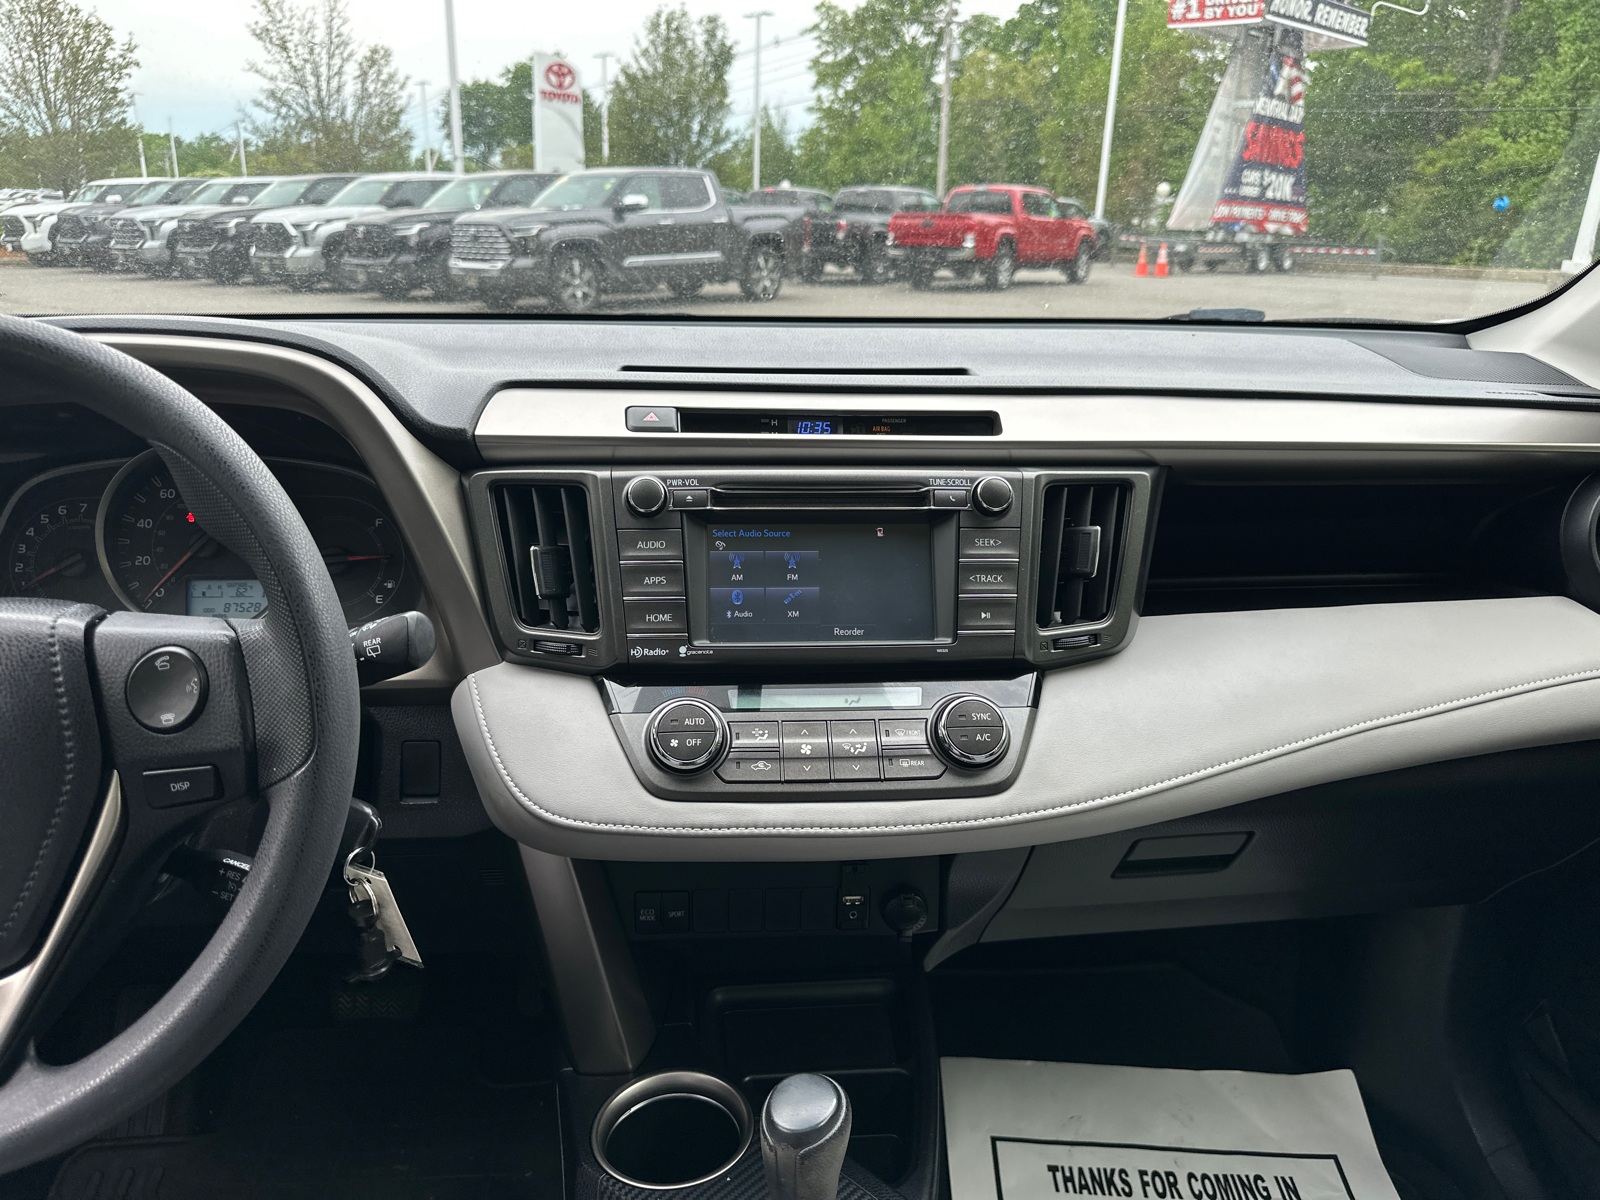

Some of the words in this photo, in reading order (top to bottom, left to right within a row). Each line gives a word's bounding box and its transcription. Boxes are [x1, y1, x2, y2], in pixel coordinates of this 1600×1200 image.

[1171, 0, 1201, 20] #1
[1203, 6, 1225, 19] BY
[1226, 2, 1259, 17] YOU
[540, 90, 581, 104] TOYOTA
[797, 421, 831, 434] 10:35
[160, 488, 176, 499] 60
[58, 505, 68, 515] 6
[79, 503, 88, 513] 7
[40, 514, 50, 524] 5
[136, 518, 153, 528] 40
[375, 518, 384, 527] F
[25, 527, 35, 537] 4
[712, 529, 737, 538] Select
[738, 529, 763, 538] Audio
[763, 529, 791, 538] Source
[17, 543, 26, 554] 3
[636, 540, 666, 549] AUDIO
[135, 555, 151, 566] 20
[15, 562, 24, 573] 2
[643, 576, 667, 585] APPS
[731, 573, 744, 581] AM
[786, 573, 799, 581] FM
[375, 594, 384, 604] E
[223, 602, 262, 613] 87528
[645, 613, 673, 622] HOME
[734, 611, 753, 619] Audio
[834, 627, 865, 636] Reorder
[363, 637, 382, 648] REAR
[684, 717, 706, 726] AUTO
[971, 712, 992, 721] SYNC
[975, 732, 992, 742] A/C
[685, 738, 702, 747] OFF
[910, 759, 925, 767] REAR
[170, 781, 191, 791] DISP
[226, 870, 242, 881] RES
[220, 891, 235, 901] SET
[668, 910, 685, 918] SPORT
[1047, 1164, 1133, 1197] THANKS
[1138, 1169, 1183, 1200] FOR
[1187, 1171, 1272, 1200] COMING
[1273, 1175, 1301, 1200] IN
